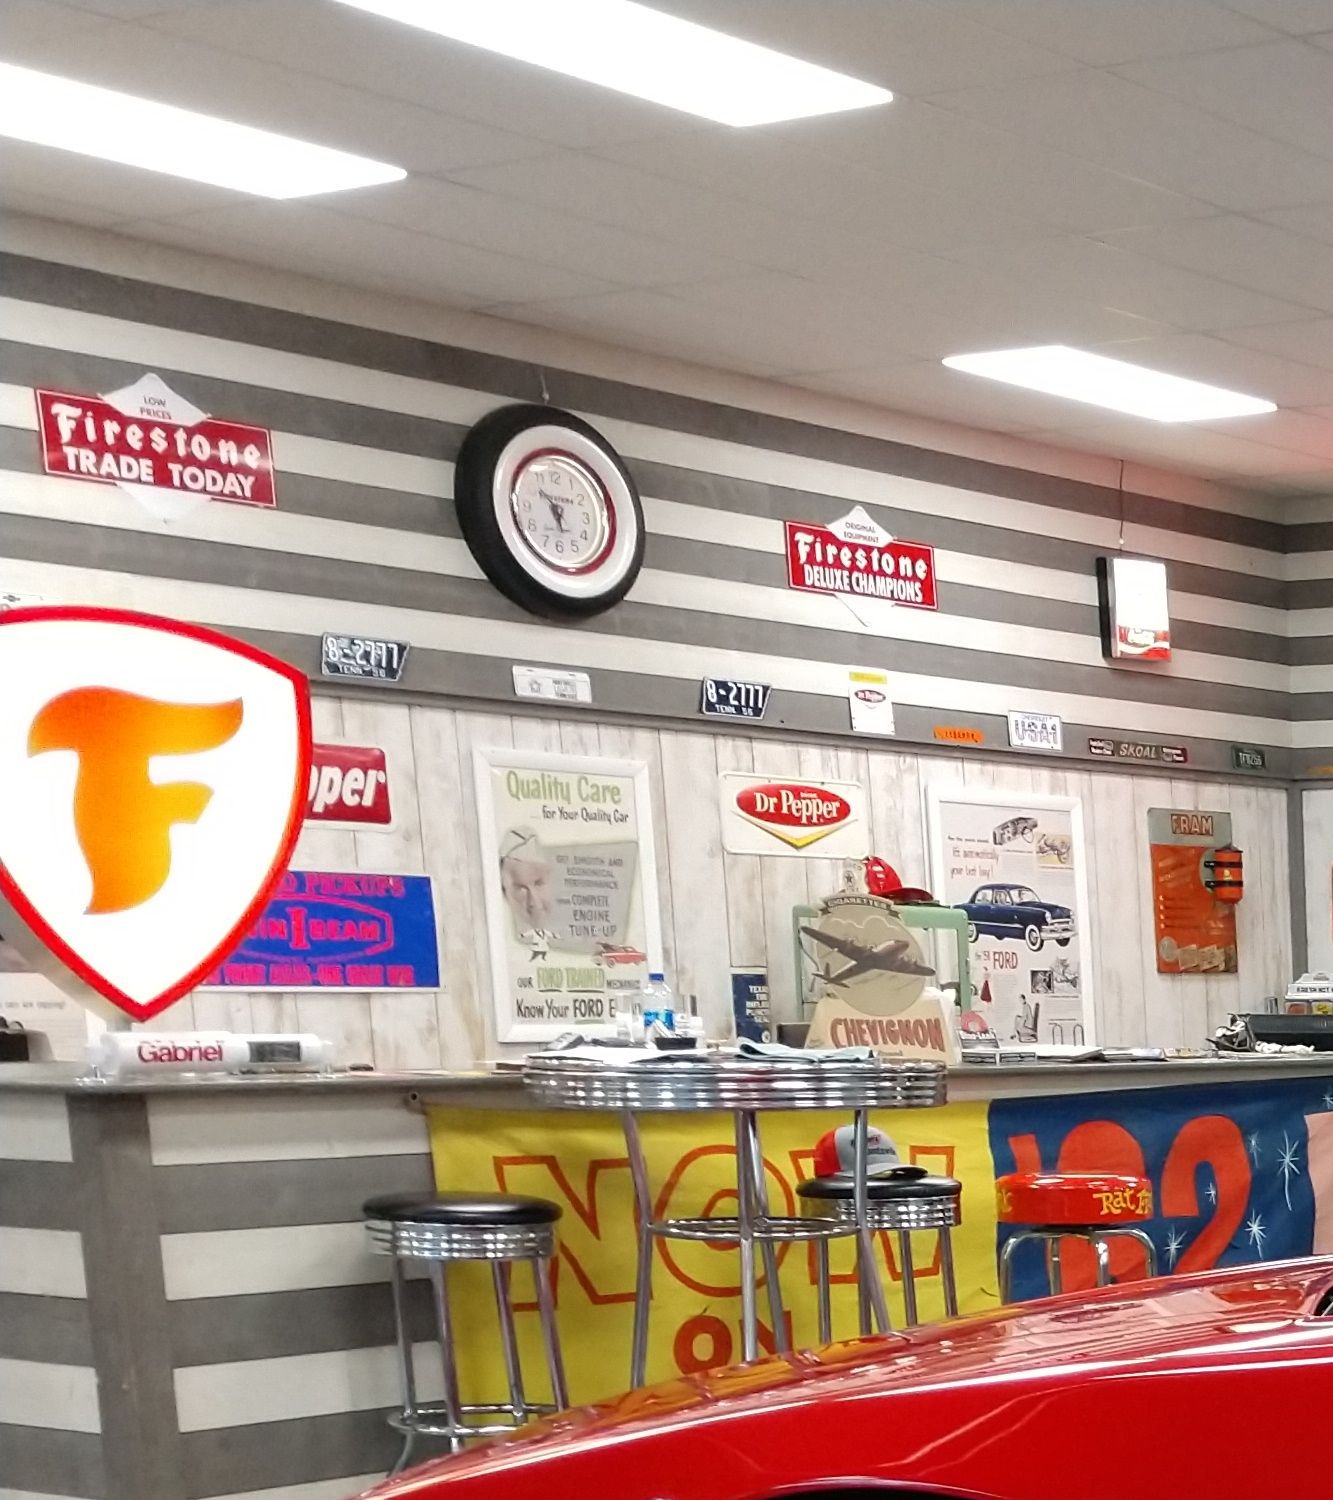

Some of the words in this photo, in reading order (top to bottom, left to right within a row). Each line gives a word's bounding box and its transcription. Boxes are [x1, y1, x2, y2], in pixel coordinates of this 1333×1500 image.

[144, 396, 166, 407] LOW
[140, 407, 172, 420] PRICES
[51, 402, 261, 469] Firestone
[63, 445, 154, 483] TRADE
[168, 463, 255, 498] TODAY
[844, 531, 879, 544] EQUIPMENT
[845, 522, 876, 534] ORIGINAL
[794, 531, 927, 580] Firestone
[804, 564, 849, 591] DELUXE
[851, 571, 923, 603] CHAMPIONS
[327, 637, 398, 669] 8-2777
[706, 680, 764, 708] 8-2777
[1119, 744, 1158, 759] SKOAL
[309, 765, 387, 813] per
[506, 770, 572, 804] Quality
[576, 776, 622, 804] Care
[558, 806, 579, 821] Your
[581, 808, 612, 825] Quality
[613, 809, 629, 823] Car
[753, 791, 778, 813] Dr
[780, 789, 840, 824] Pepper
[1170, 813, 1214, 836] FRAM
[305, 873, 406, 897] PICKUPS
[571, 894, 610, 908] COMPLETE
[573, 910, 611, 922] ENGINE
[248, 919, 288, 941] IN
[309, 919, 381, 941] BEAM
[568, 924, 617, 938] TUNE-UP
[992, 951, 1019, 970] FORD
[516, 976, 534, 989] OUR
[537, 967, 564, 989] FORD
[516, 998, 544, 1019] Know
[545, 999, 570, 1018] Your
[573, 998, 604, 1019] FORD
[830, 1017, 946, 1053] CHEVIGNON
[137, 1040, 225, 1064] Gabriel
[1093, 1188, 1133, 1216] Rat
